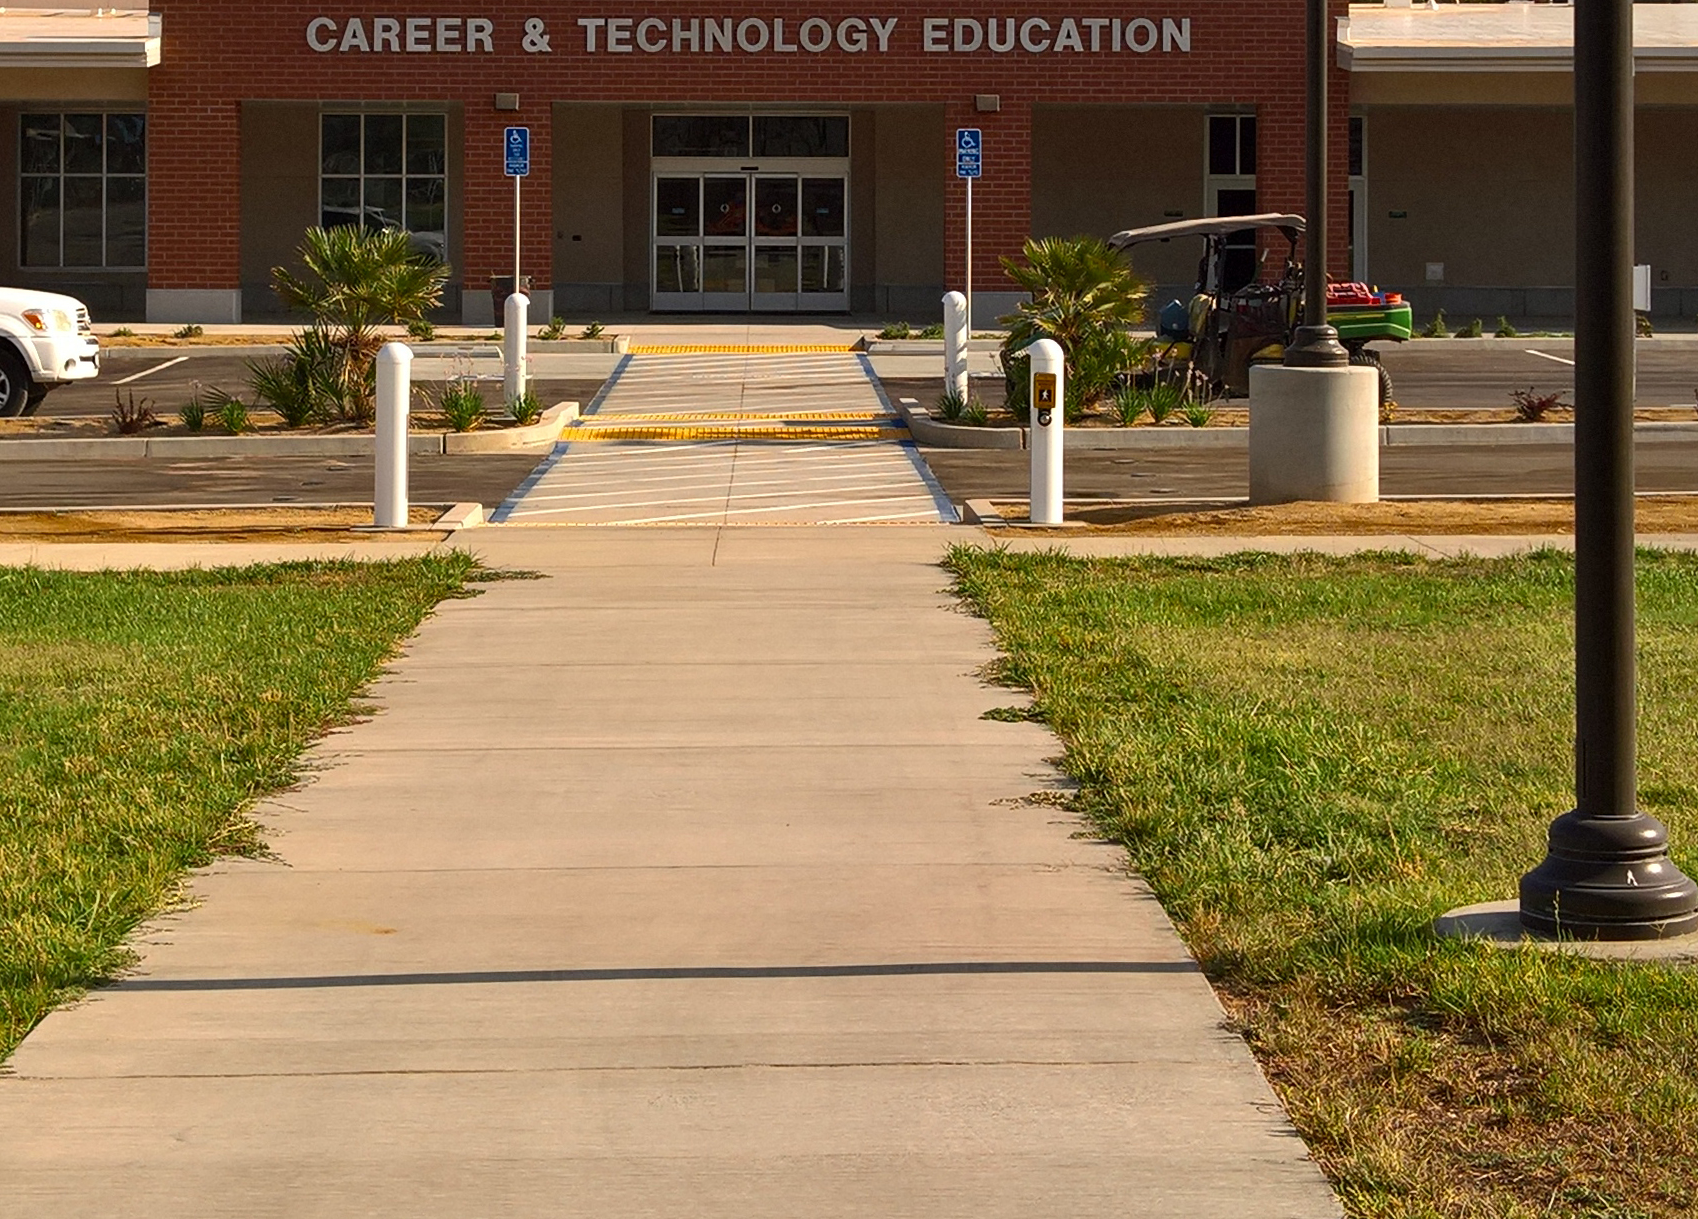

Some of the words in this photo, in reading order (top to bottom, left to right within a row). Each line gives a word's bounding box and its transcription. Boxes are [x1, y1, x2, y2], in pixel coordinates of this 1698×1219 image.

[306, 17, 494, 52] CAREER
[522, 17, 553, 52] &
[578, 17, 898, 53] TECHNOLOGY
[923, 17, 1191, 52] EDUCATION
